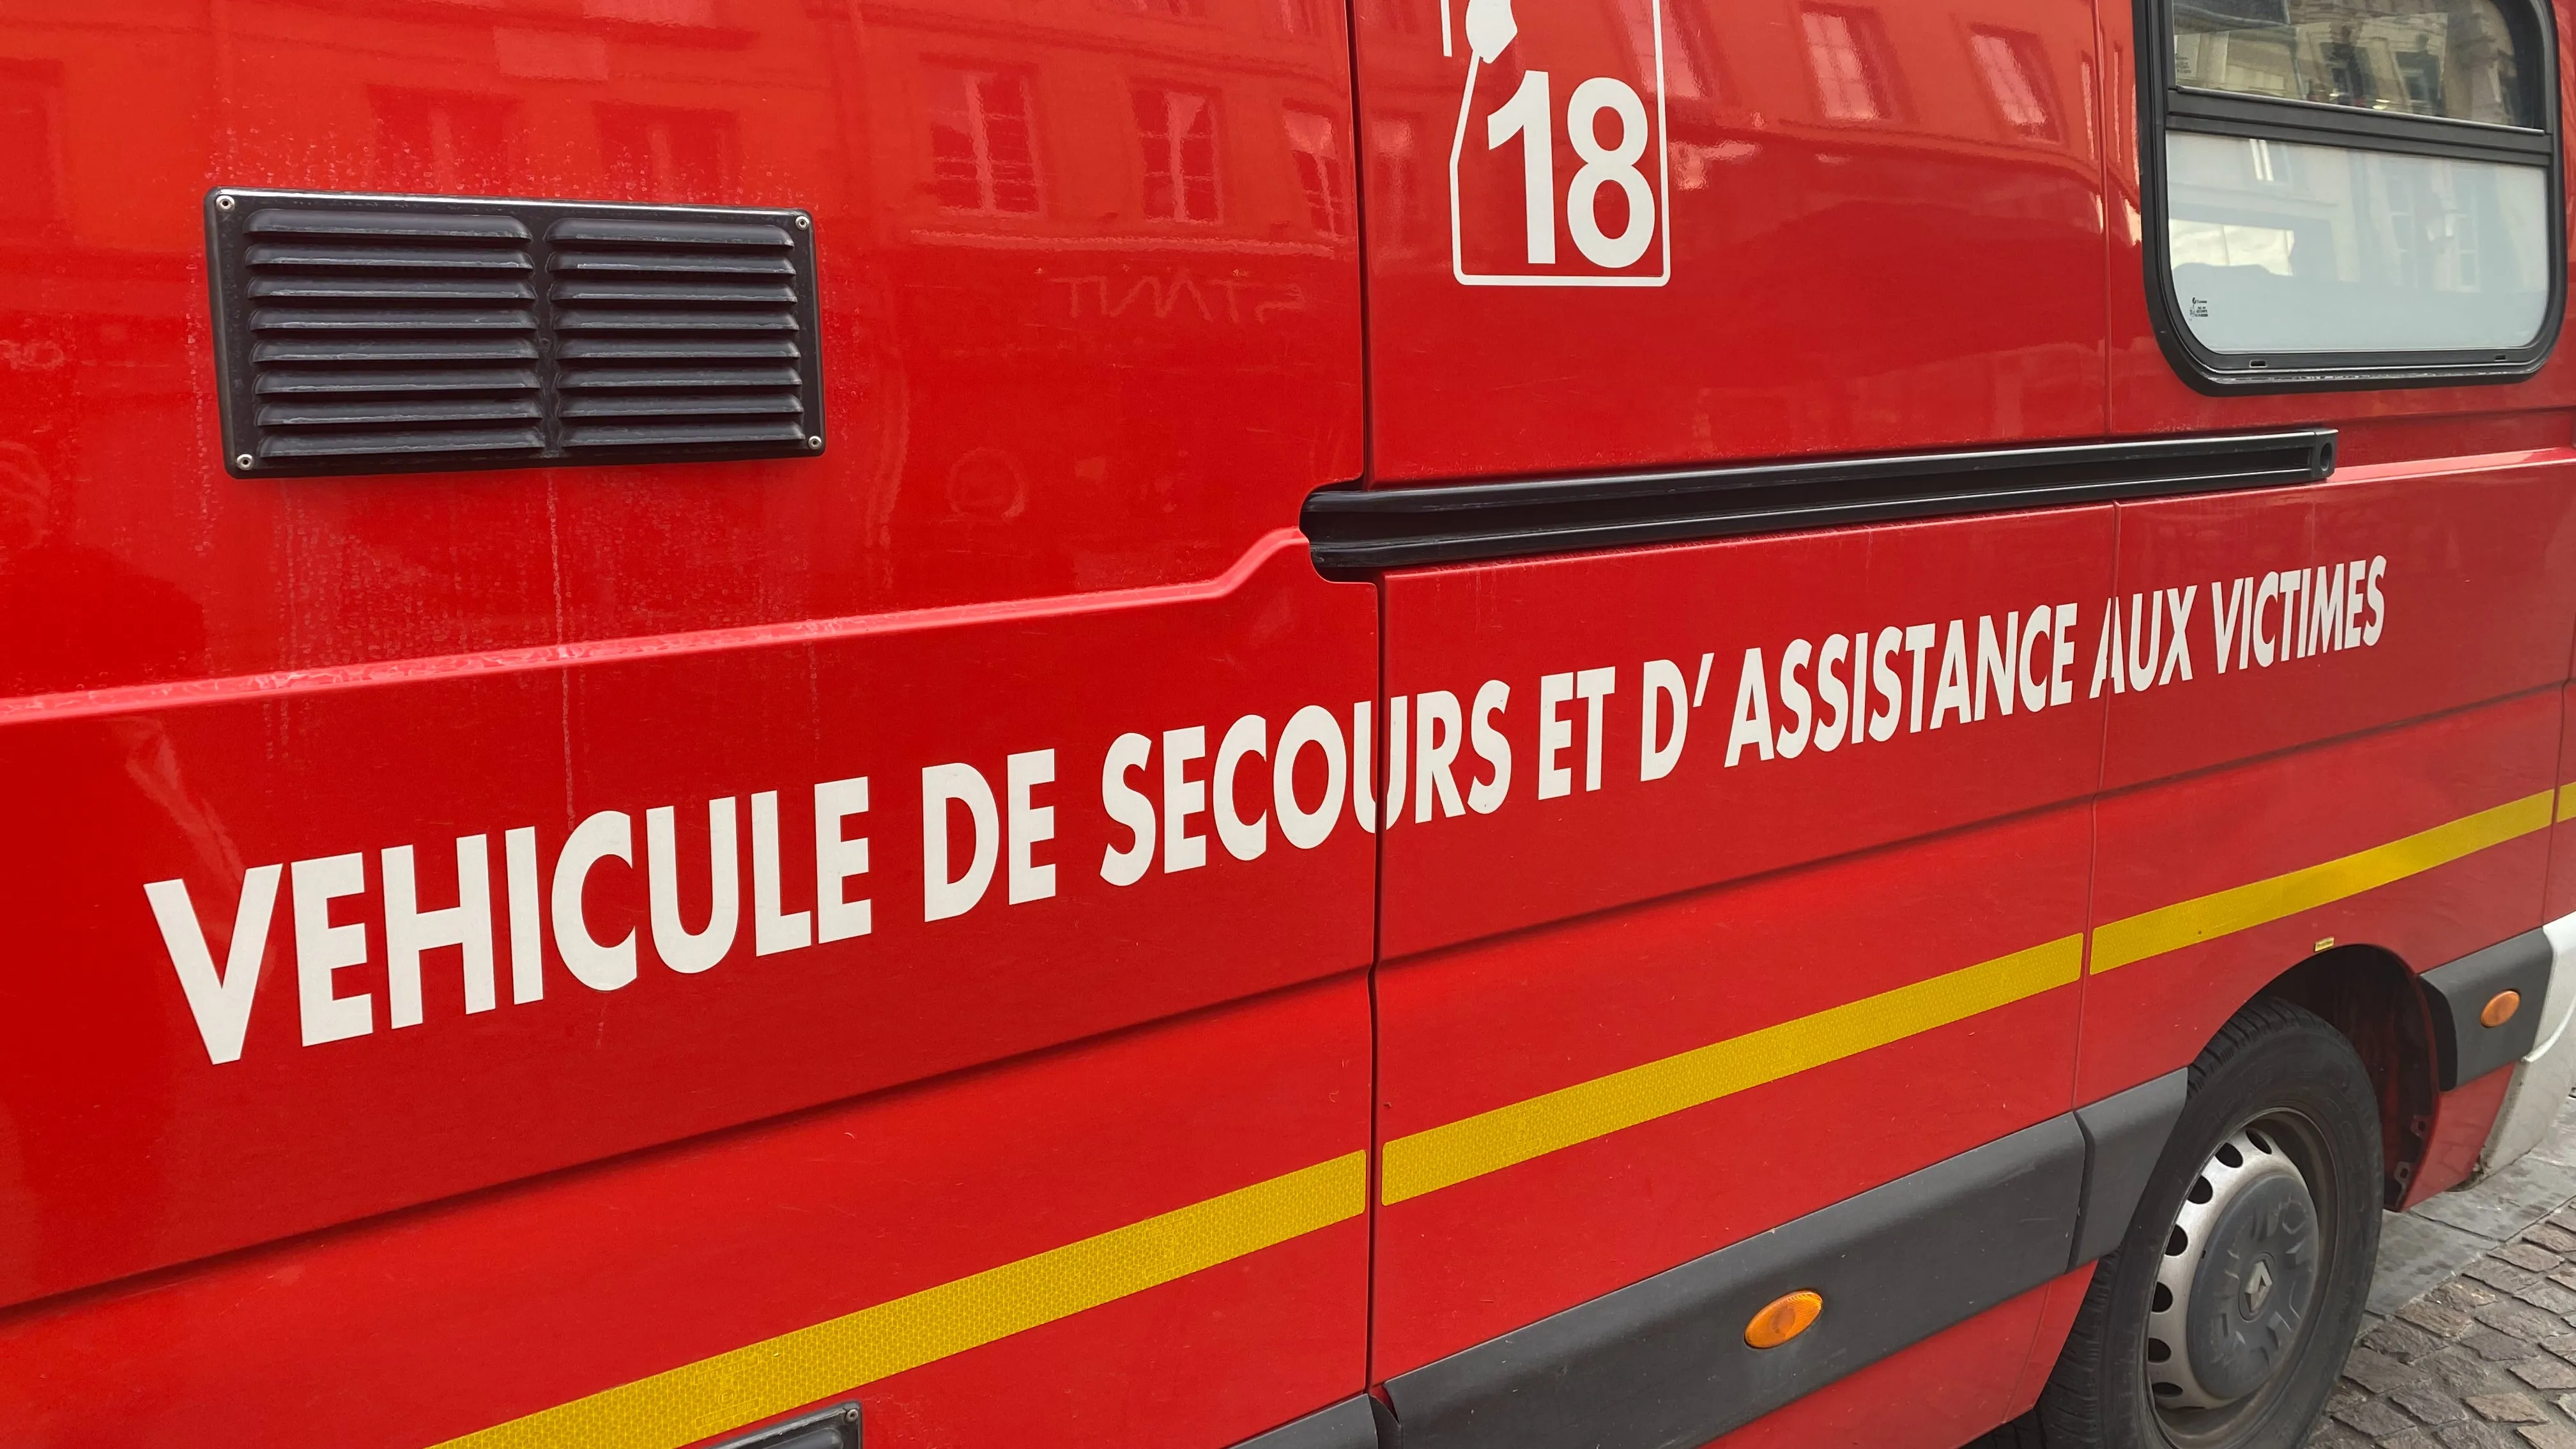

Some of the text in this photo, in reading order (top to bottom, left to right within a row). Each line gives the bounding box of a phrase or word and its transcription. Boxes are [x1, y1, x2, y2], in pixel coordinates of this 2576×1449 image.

[1487, 70, 1655, 268] 18
[144, 776, 871, 1064] VEHICULE
[923, 749, 1055, 922] DE
[1100, 680, 1511, 885] SECOURS
[1538, 666, 1615, 800] ET
[1724, 603, 2077, 767] ASSISTANCE
[2089, 585, 2197, 698] AUX
[2212, 555, 2386, 673] VICTIMES
